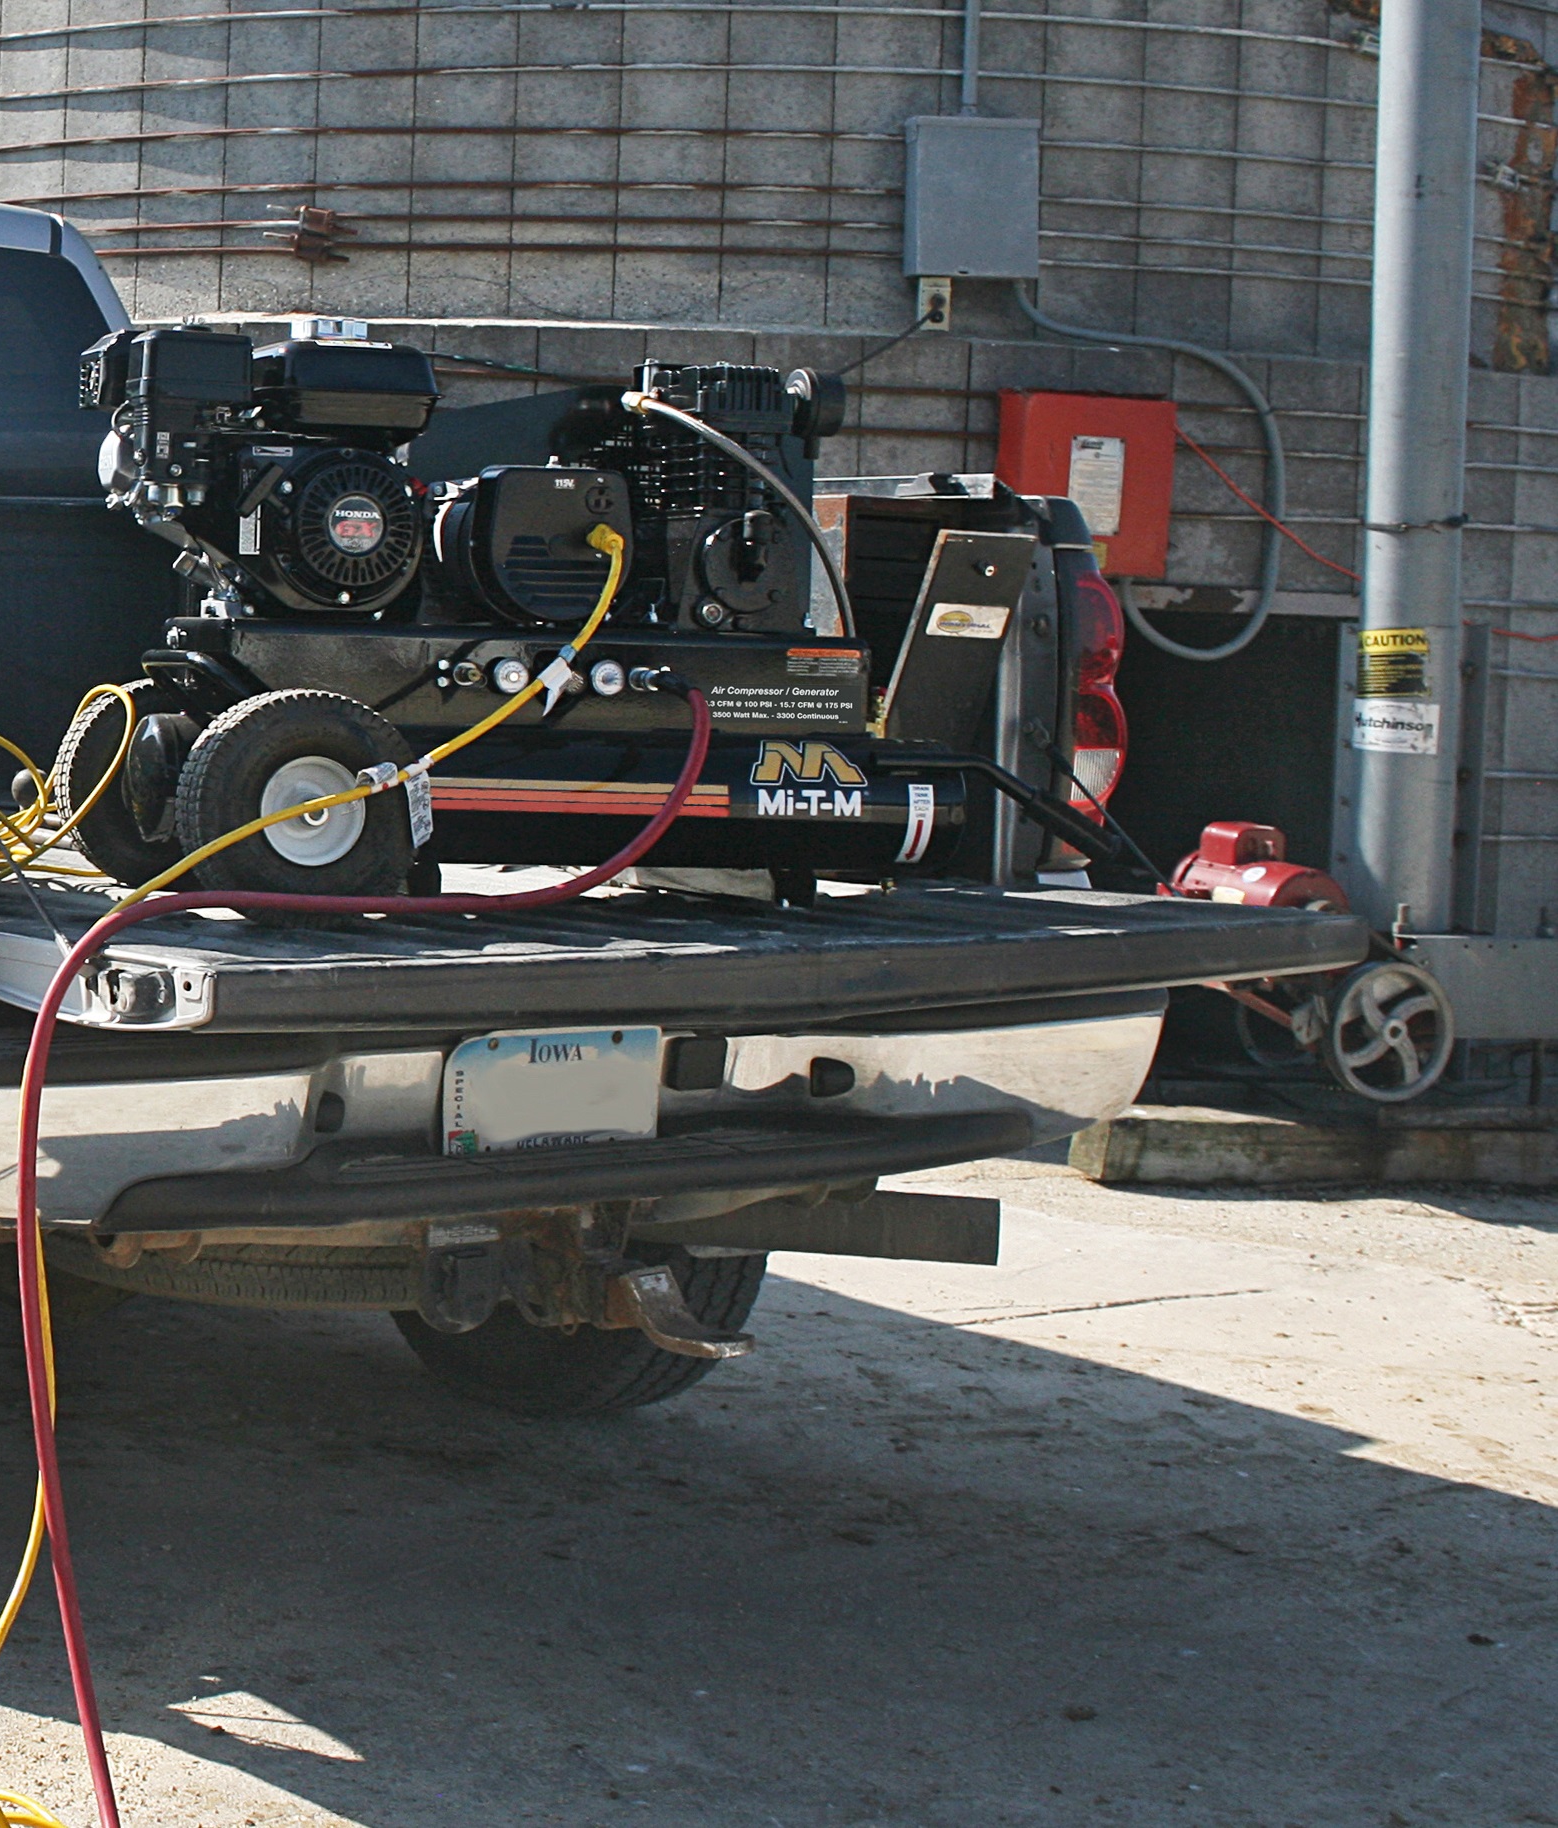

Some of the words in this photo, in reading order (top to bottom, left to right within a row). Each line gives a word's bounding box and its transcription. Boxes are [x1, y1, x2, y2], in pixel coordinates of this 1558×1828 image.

[334, 509, 381, 519] HONDA
[334, 520, 378, 538] GX
[1364, 634, 1426, 647] CAUTION
[711, 686, 726, 695] Air
[726, 686, 784, 697] Compressor
[791, 687, 840, 697] Generator
[744, 700, 758, 708] 100
[732, 711, 750, 719] Watt
[751, 711, 770, 719] Max.
[796, 712, 839, 720] Continuous
[757, 788, 862, 817] Mi-T-M
[528, 1038, 583, 1064] IOWA
